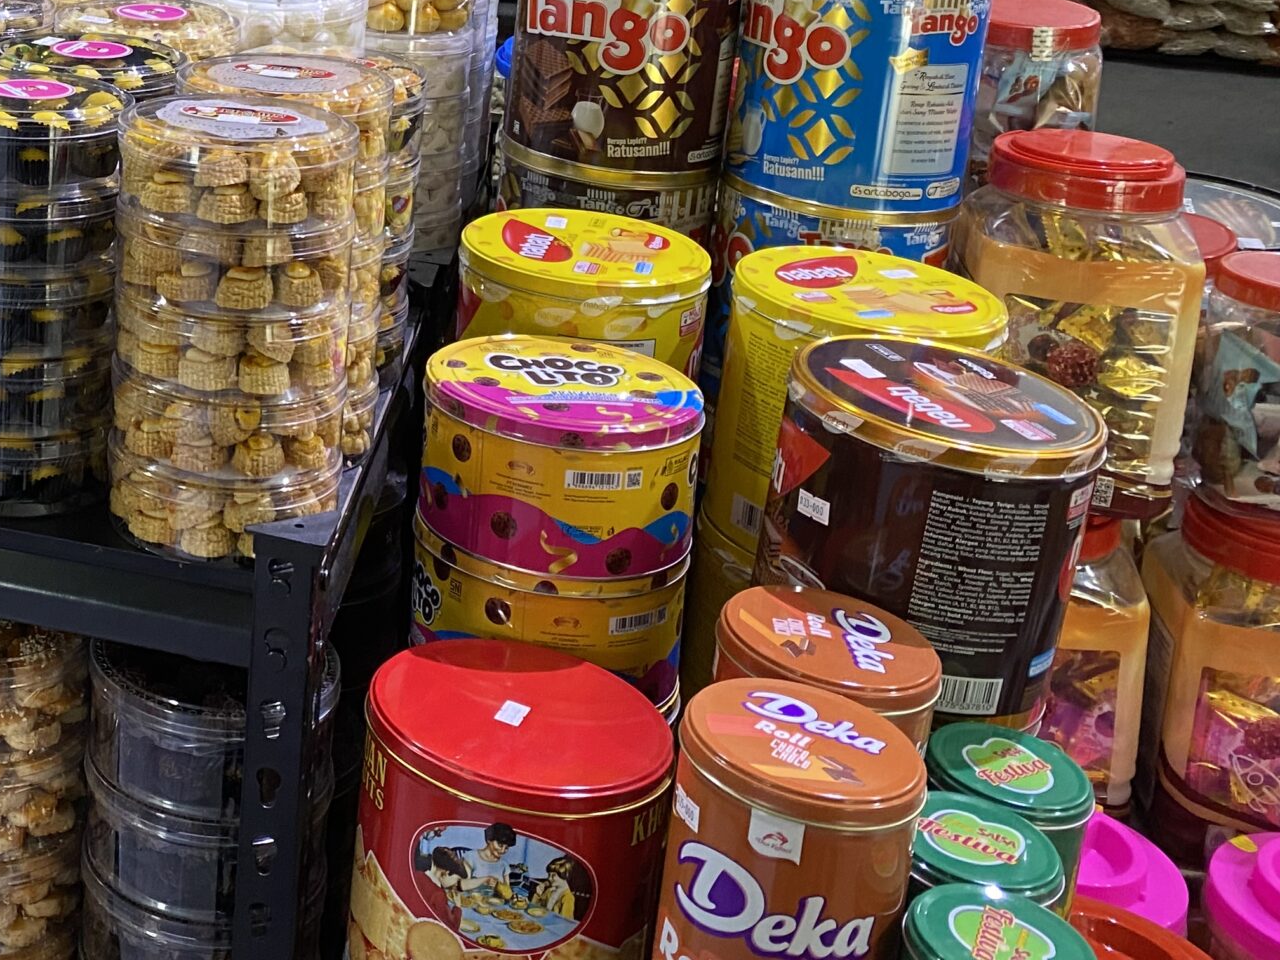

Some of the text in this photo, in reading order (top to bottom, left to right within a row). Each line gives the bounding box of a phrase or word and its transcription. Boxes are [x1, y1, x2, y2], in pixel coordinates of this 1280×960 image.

[607, 142, 670, 158] Ratusann!!!
[763, 161, 825, 181] Ratusann!!!
[778, 263, 853, 282] nabati
[886, 386, 972, 428] nabati
[449, 577, 462, 591] SNI
[807, 612, 832, 639] Roll
[832, 608, 895, 673] Deka
[742, 691, 888, 756] Deka
[754, 720, 815, 747] Roll
[976, 758, 1052, 786] Festiva
[918, 818, 1018, 864] Festiva
[676, 840, 875, 958] Deka
